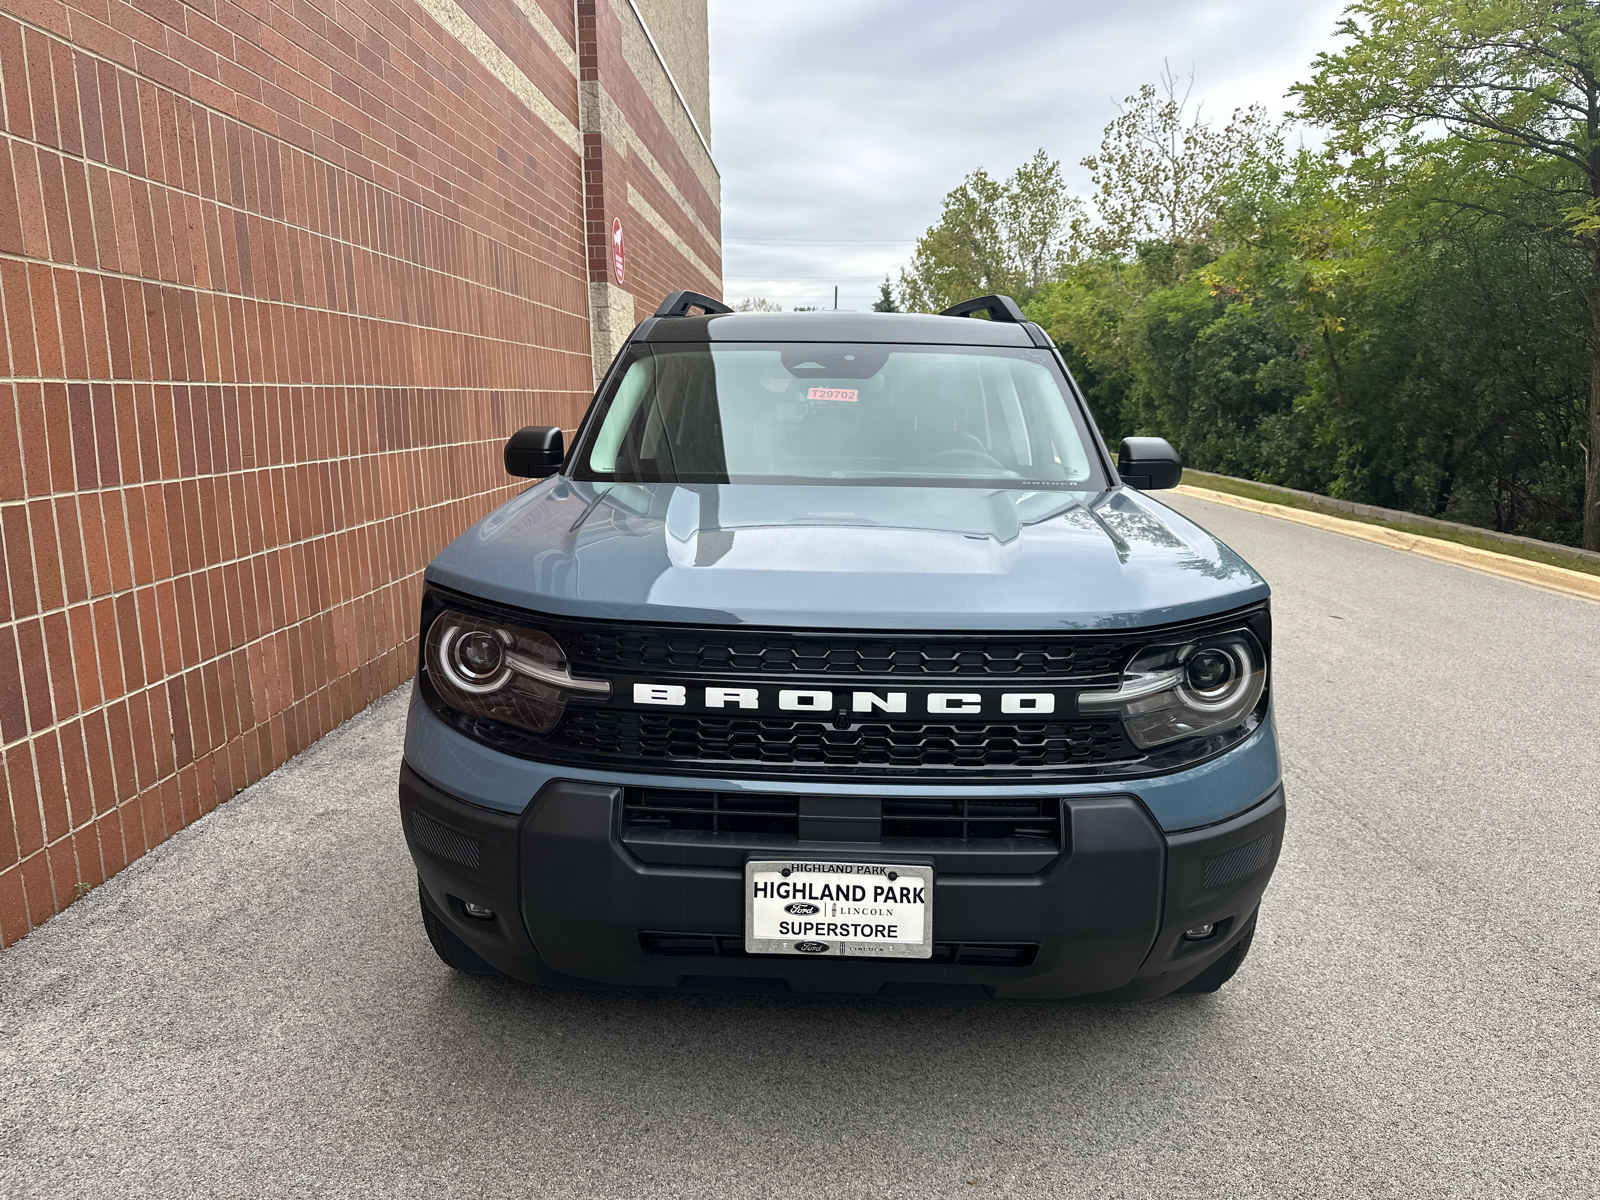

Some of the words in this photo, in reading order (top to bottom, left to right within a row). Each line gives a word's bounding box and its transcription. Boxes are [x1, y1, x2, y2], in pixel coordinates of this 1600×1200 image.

[811, 389, 856, 399] T29702
[633, 683, 1055, 713] BRONCO
[791, 863, 853, 874] HIGHLAND
[856, 866, 887, 876] PARK
[753, 881, 866, 902] HIGHLAND
[873, 886, 925, 904] PARK
[789, 904, 814, 915] Ford
[840, 907, 893, 916] LINCOLN
[779, 921, 898, 938] SUPERSTORE
